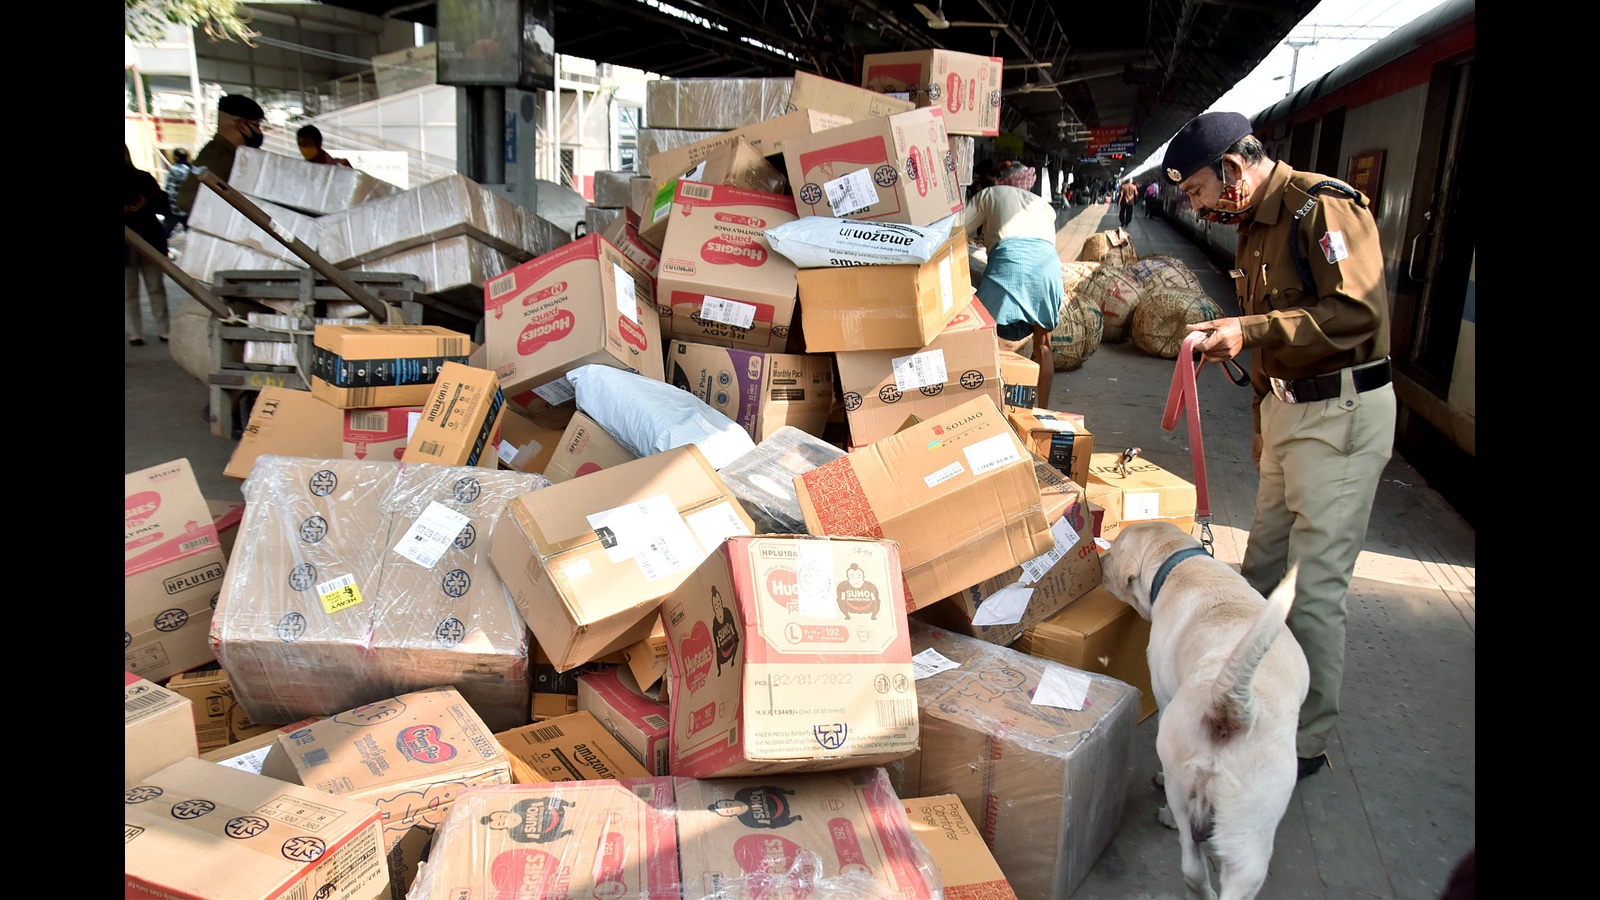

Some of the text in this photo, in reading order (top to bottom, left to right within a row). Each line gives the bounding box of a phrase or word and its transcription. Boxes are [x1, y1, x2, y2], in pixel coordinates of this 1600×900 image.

[714, 225, 764, 236] MONTHLY PACK
[720, 234, 752, 244] pants
[839, 228, 914, 246] amazon.in
[707, 242, 762, 261] HUGGIES
[522, 296, 568, 318] MONTHLY PACK
[530, 306, 560, 325] pants
[520, 316, 570, 343] HUGGIES
[702, 329, 745, 340] READY
[773, 370, 803, 380] Monthly Pack
[427, 382, 450, 422] amazon.in
[945, 411, 984, 432] SOLIMO
[168, 568, 222, 593] HPLU1R3
[331, 597, 356, 610] HEAVY
[845, 590, 871, 599] SUMO
[718, 624, 731, 642] SUMO
[789, 626, 797, 640] L
[826, 628, 840, 637] 192
[684, 645, 712, 678] HUGGIES
[772, 673, 853, 686] 02/01/2022
[751, 796, 765, 819] SUMO
[524, 806, 536, 833] SUMO
[932, 804, 959, 842] Comforter
[949, 803, 970, 835] Premium
[832, 826, 846, 840] 192
[603, 842, 613, 856] 192
[519, 853, 546, 900] GGIES
